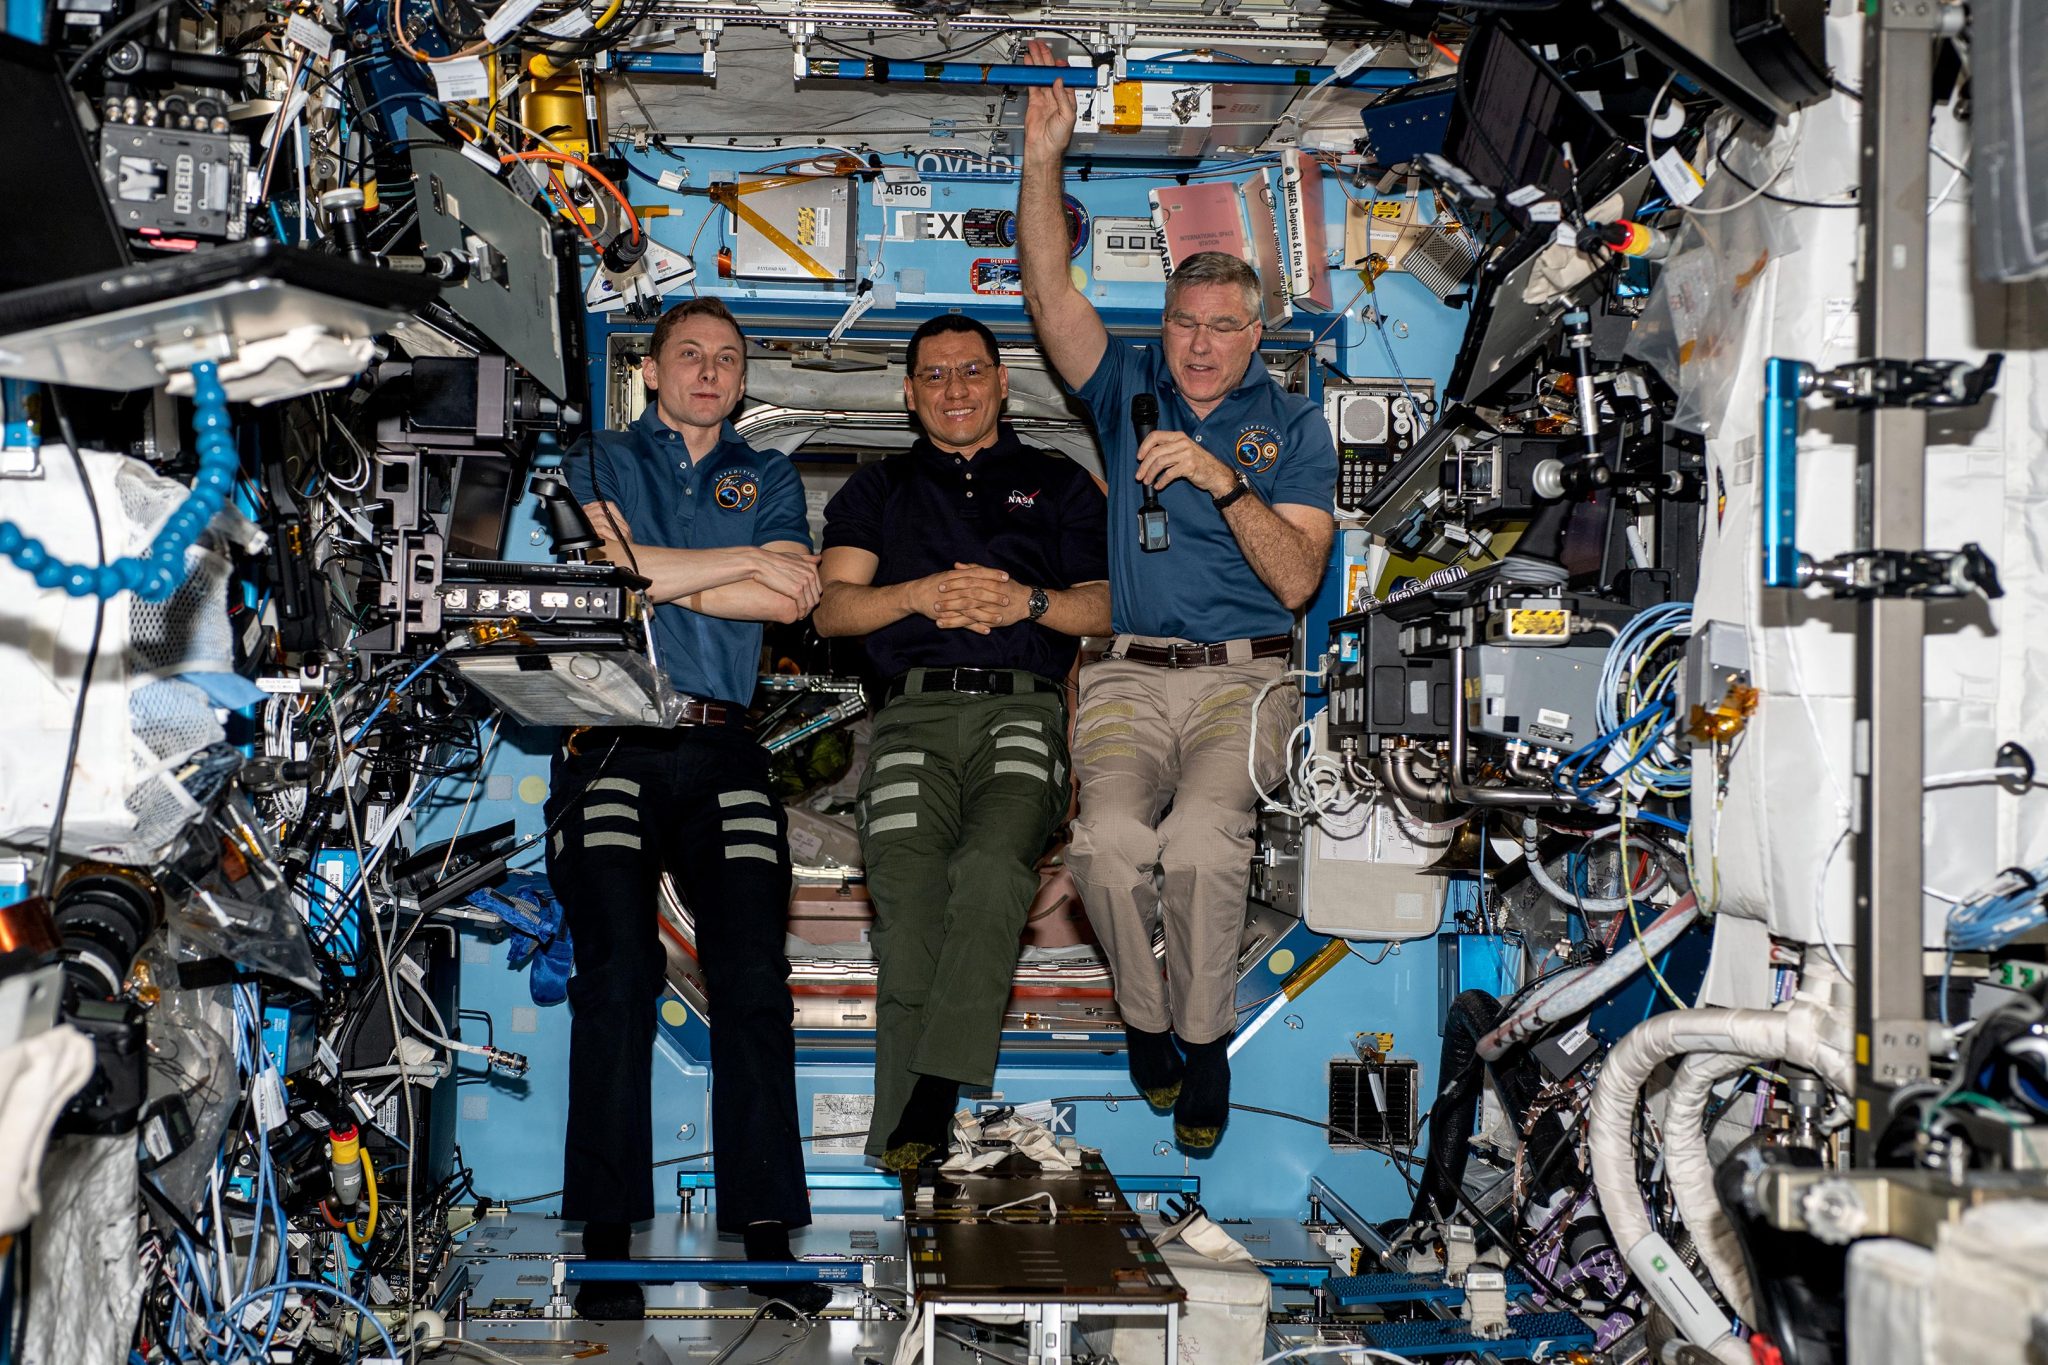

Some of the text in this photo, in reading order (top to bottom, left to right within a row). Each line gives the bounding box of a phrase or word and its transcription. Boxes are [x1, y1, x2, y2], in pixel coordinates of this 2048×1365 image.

[918, 154, 1012, 172] OVHD
[174, 153, 194, 214] RED
[1288, 207, 1300, 242] Depress
[1179, 230, 1234, 242] INTERNATIONAL SPACE
[1292, 242, 1302, 250] &
[1292, 250, 1303, 266] Fire
[1240, 424, 1284, 446] EXPEDITION
[715, 469, 759, 482] EXPEDITION
[1008, 496, 1035, 504] NASA
